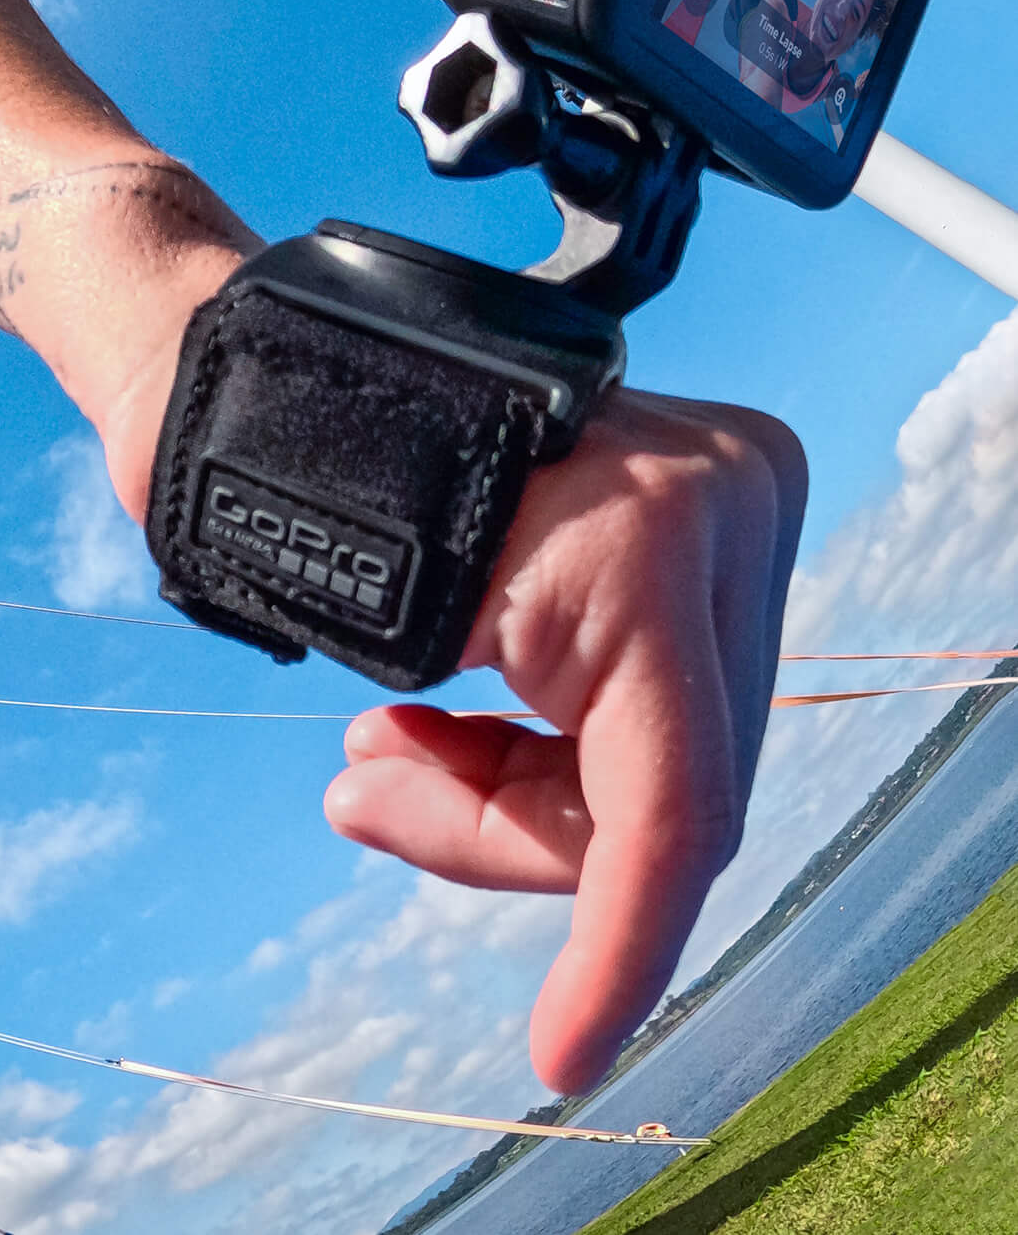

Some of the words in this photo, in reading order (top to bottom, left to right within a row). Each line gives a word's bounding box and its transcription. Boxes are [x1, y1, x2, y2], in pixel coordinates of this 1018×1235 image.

[758, 13, 779, 40] Time
[778, 31, 803, 59] Lapse
[209, 485, 391, 584] GoPro
